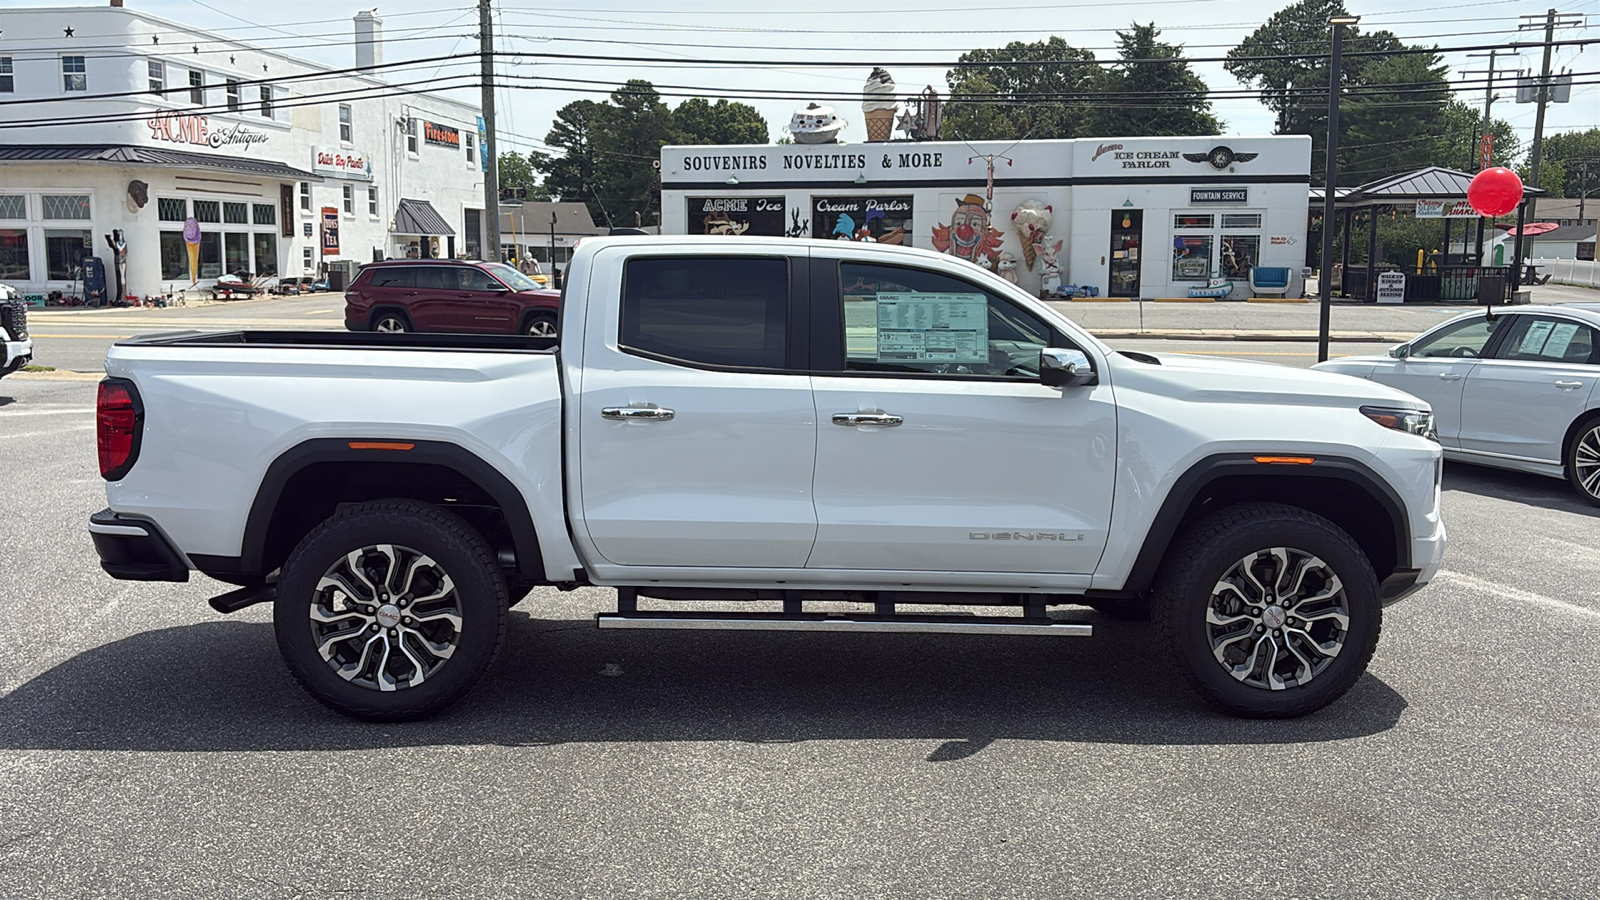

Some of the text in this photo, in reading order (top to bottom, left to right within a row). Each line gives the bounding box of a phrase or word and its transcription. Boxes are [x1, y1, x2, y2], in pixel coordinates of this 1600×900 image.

[147, 108, 210, 146] ACME
[222, 122, 269, 151] Antiques
[425, 122, 459, 144] Firestone
[317, 152, 364, 170] Dutch Boy Paints
[683, 152, 943, 170] SOUVENIRS NOVELTIES & MORE
[1114, 151, 1180, 160] ICE CREAM
[1122, 160, 1171, 168] PARLOR
[1192, 191, 1246, 200] FOUNTAIN SERVICE
[702, 199, 784, 212] ACME Ice
[816, 199, 911, 212] Cream Parlor
[968, 531, 1084, 541] DENALI
[379, 611, 398, 620] GMC
[1267, 608, 1281, 625] GMC
